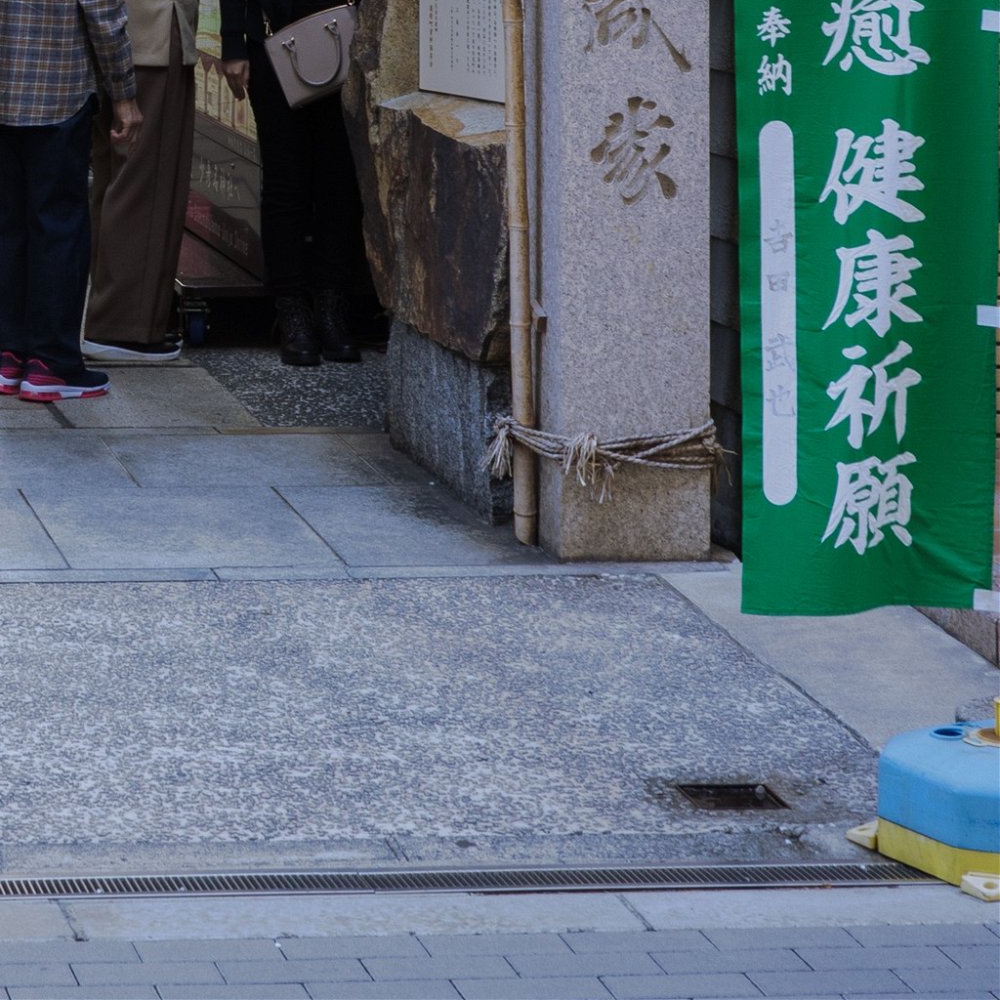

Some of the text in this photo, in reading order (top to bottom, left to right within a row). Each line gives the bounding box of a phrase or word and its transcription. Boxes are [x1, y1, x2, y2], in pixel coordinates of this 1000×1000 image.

[756, 6, 793, 97] 奉納
[819, 118, 927, 556] 健康祈願
